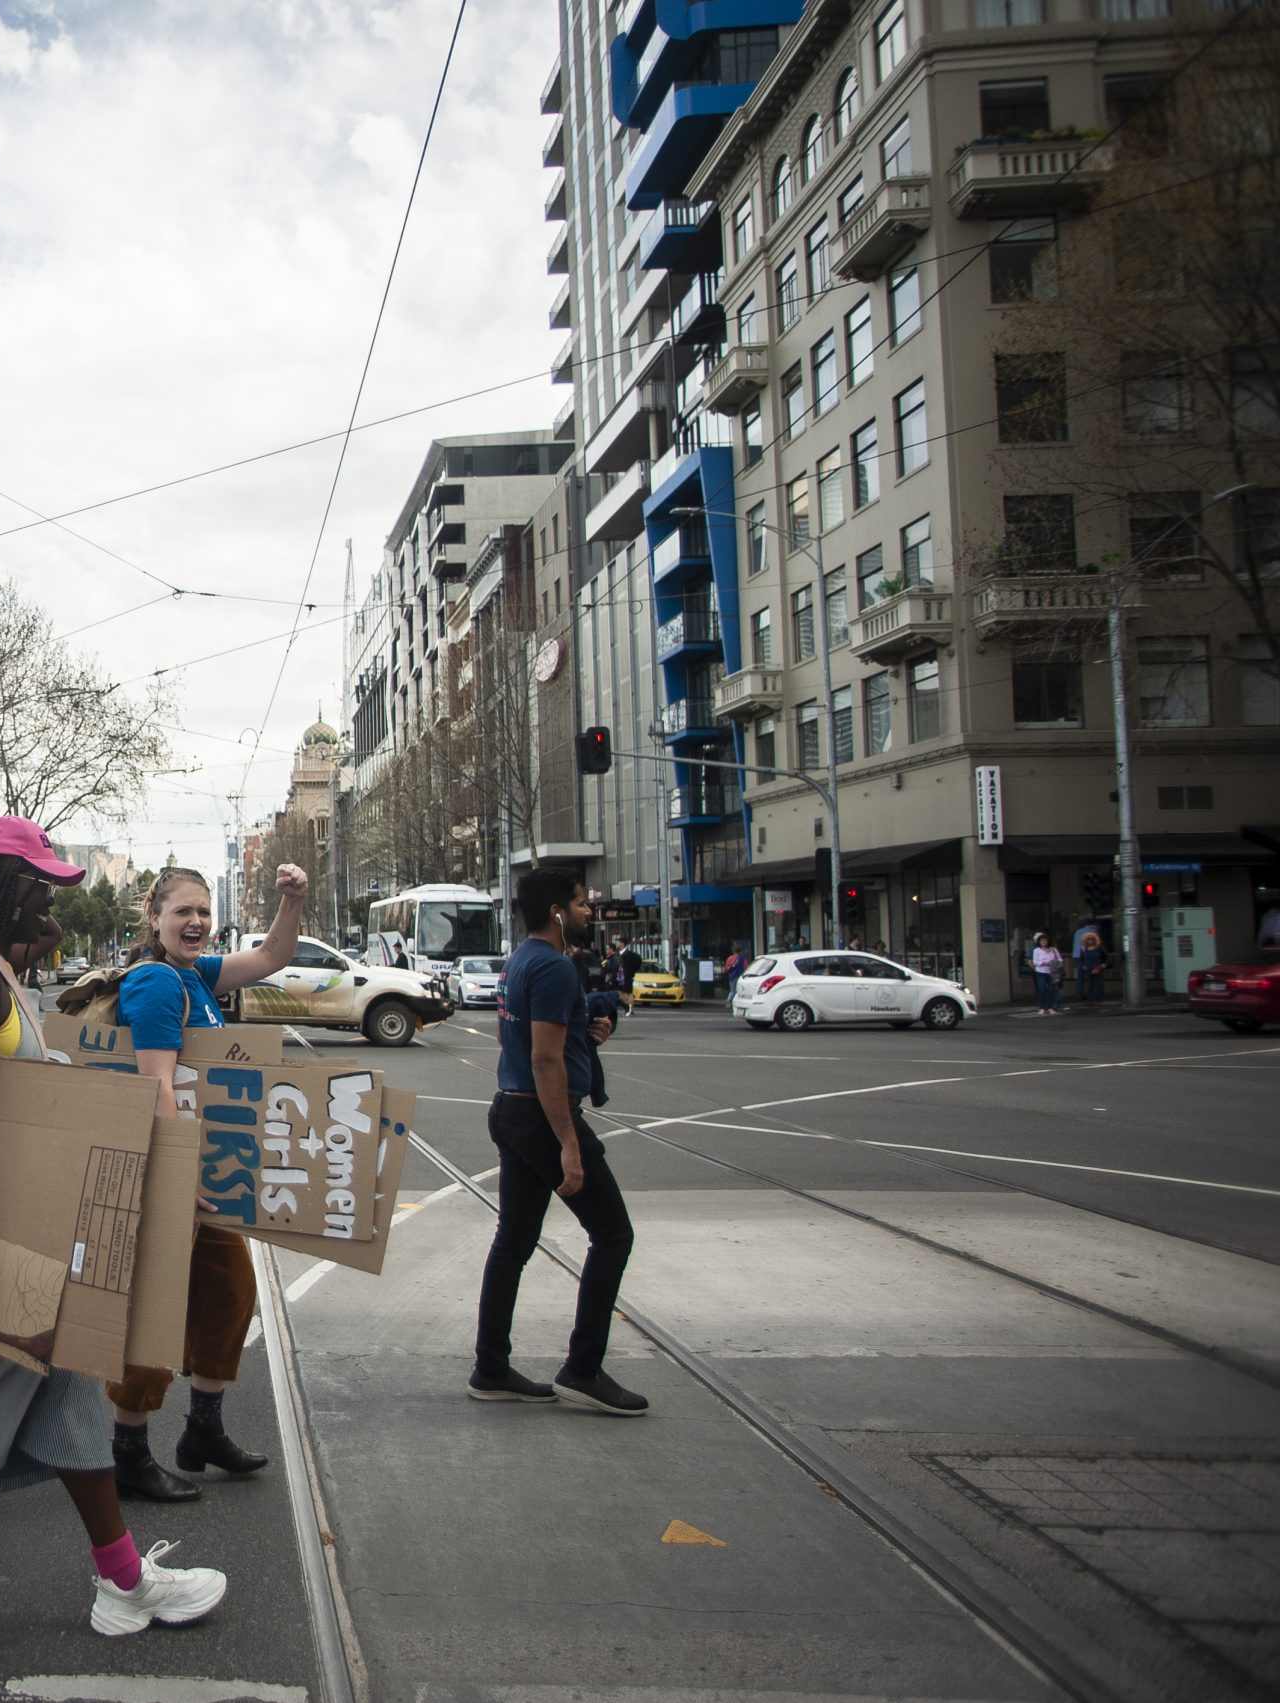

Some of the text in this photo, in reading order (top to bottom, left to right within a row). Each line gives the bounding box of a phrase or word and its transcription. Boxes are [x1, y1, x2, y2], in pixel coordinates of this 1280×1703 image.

[989, 770, 999, 840] VACATION
[200, 1067, 264, 1226] FIRST
[325, 1070, 375, 1240] Women
[109, 1249, 121, 1281] TOOLS
[114, 1220, 125, 1249] HAND
